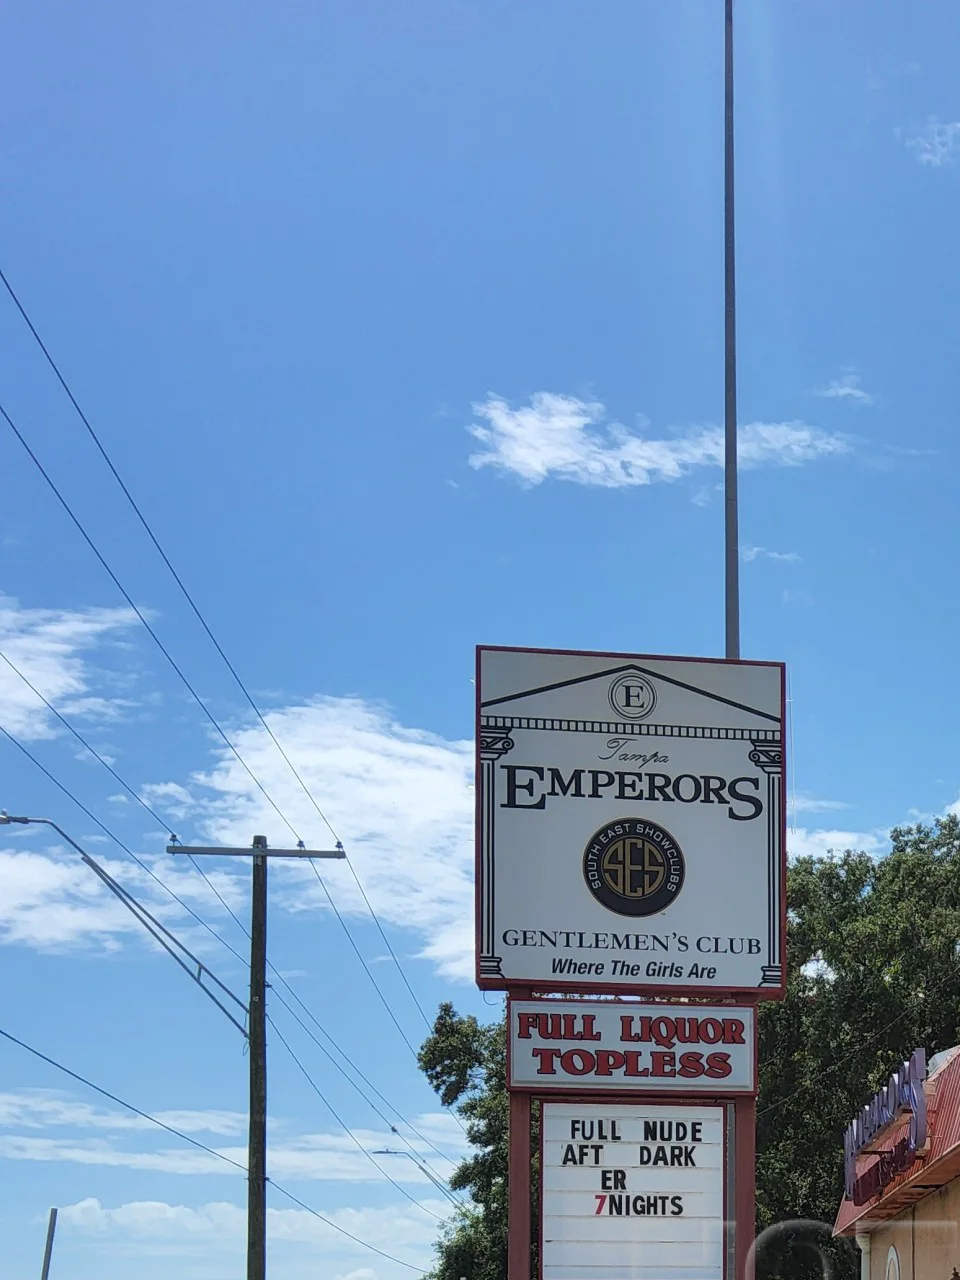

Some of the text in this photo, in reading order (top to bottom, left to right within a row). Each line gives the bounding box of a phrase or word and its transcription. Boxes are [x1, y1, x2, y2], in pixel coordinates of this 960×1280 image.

[621, 684, 645, 709] E
[598, 737, 670, 769] Tampa
[499, 764, 764, 821] EMPERORS
[587, 823, 680, 892] SOUTH EAST SHOWCLUBS
[603, 838, 665, 897] SES
[502, 929, 762, 955] GENTLEMEN'S CLUB
[551, 957, 717, 979] Where The Girls Are
[517, 1012, 746, 1049] FULL LIQUOR
[532, 1047, 733, 1079] TOPLESS
[570, 1119, 703, 1143] FULL NUDE
[562, 1144, 697, 1167] AFT DARK
[602, 1169, 627, 1190] ER
